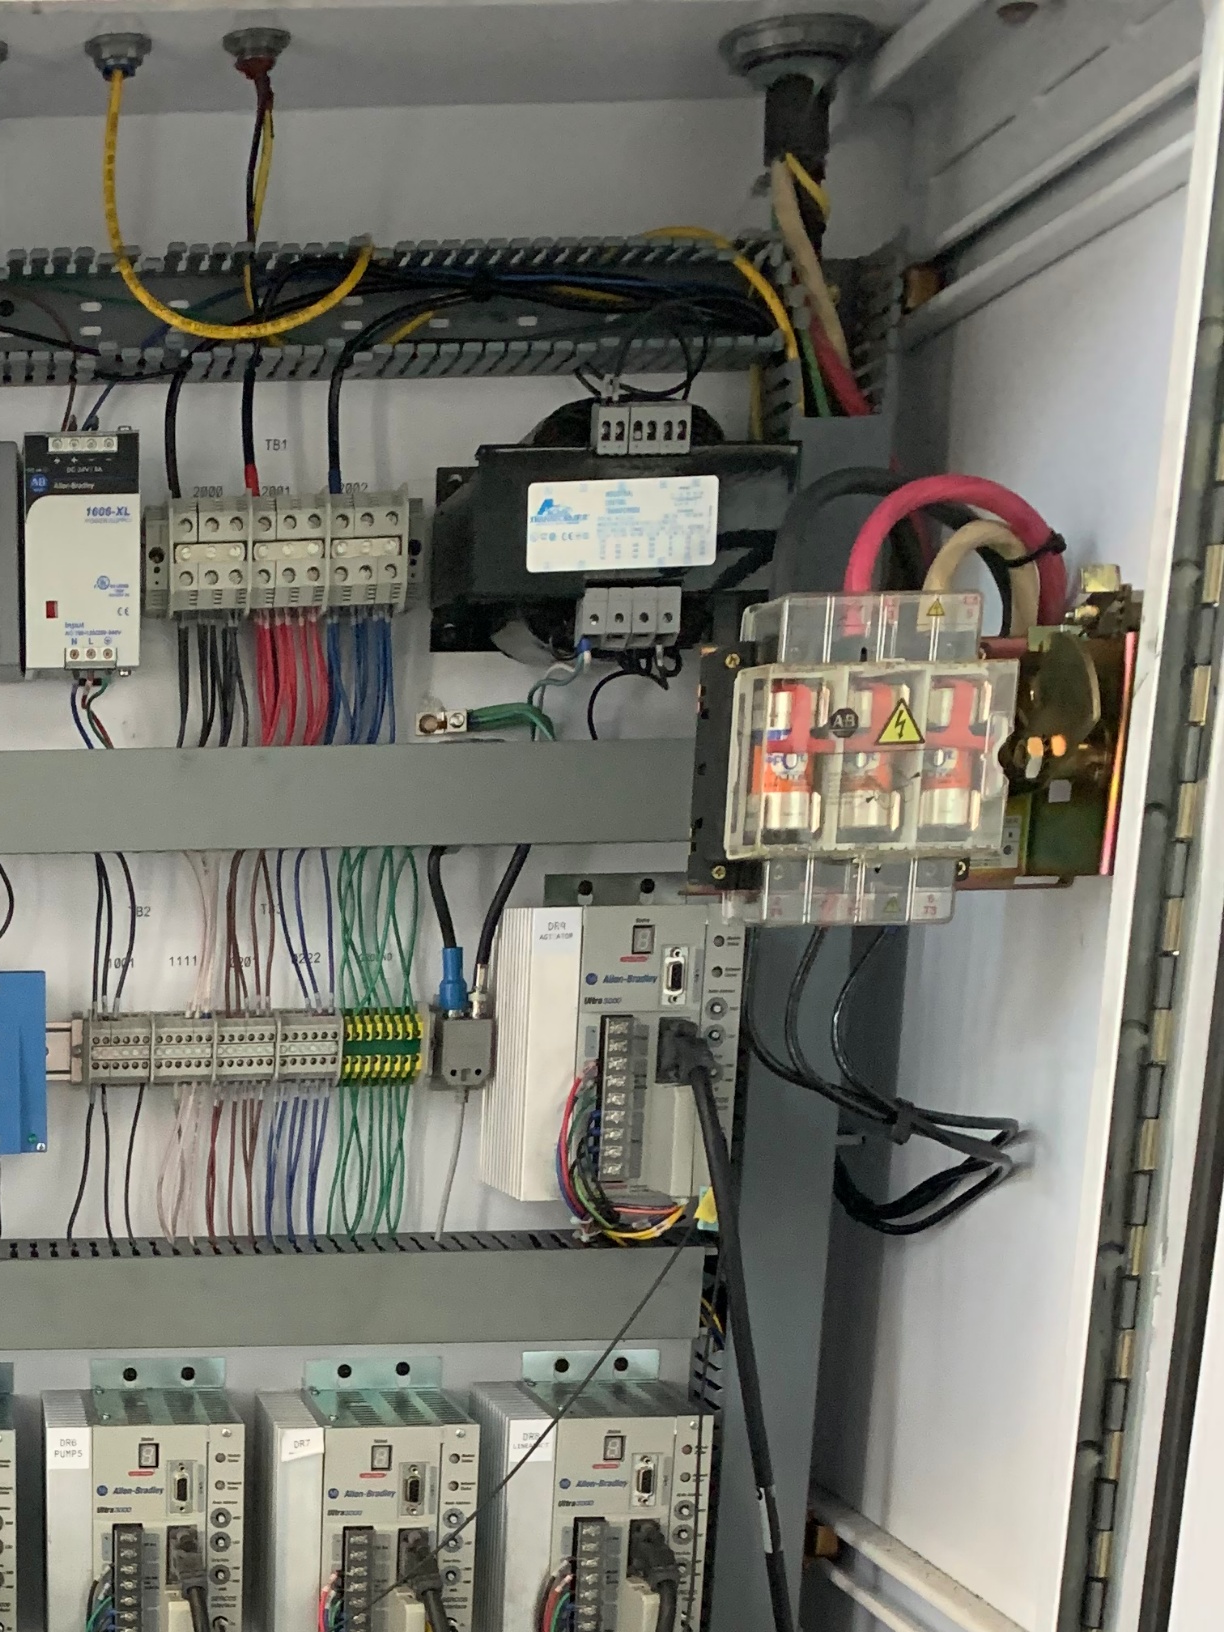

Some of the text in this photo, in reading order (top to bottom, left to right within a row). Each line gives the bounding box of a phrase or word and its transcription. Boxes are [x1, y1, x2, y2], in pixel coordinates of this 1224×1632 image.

[265, 438, 288, 451] TB1
[192, 485, 224, 498] 2000
[261, 486, 291, 497] 2001
[86, 506, 131, 517] 1606-XL
[547, 921, 567, 931] DR9
[169, 955, 198, 967] 1111
[602, 973, 659, 985] Allen-Bradley
[293, 1439, 311, 1449] DR7
[54, 1449, 83, 1459] PUMP5
[112, 1486, 165, 1496] Allen-Bradley
[343, 1488, 397, 1499] Allen-Bradley
